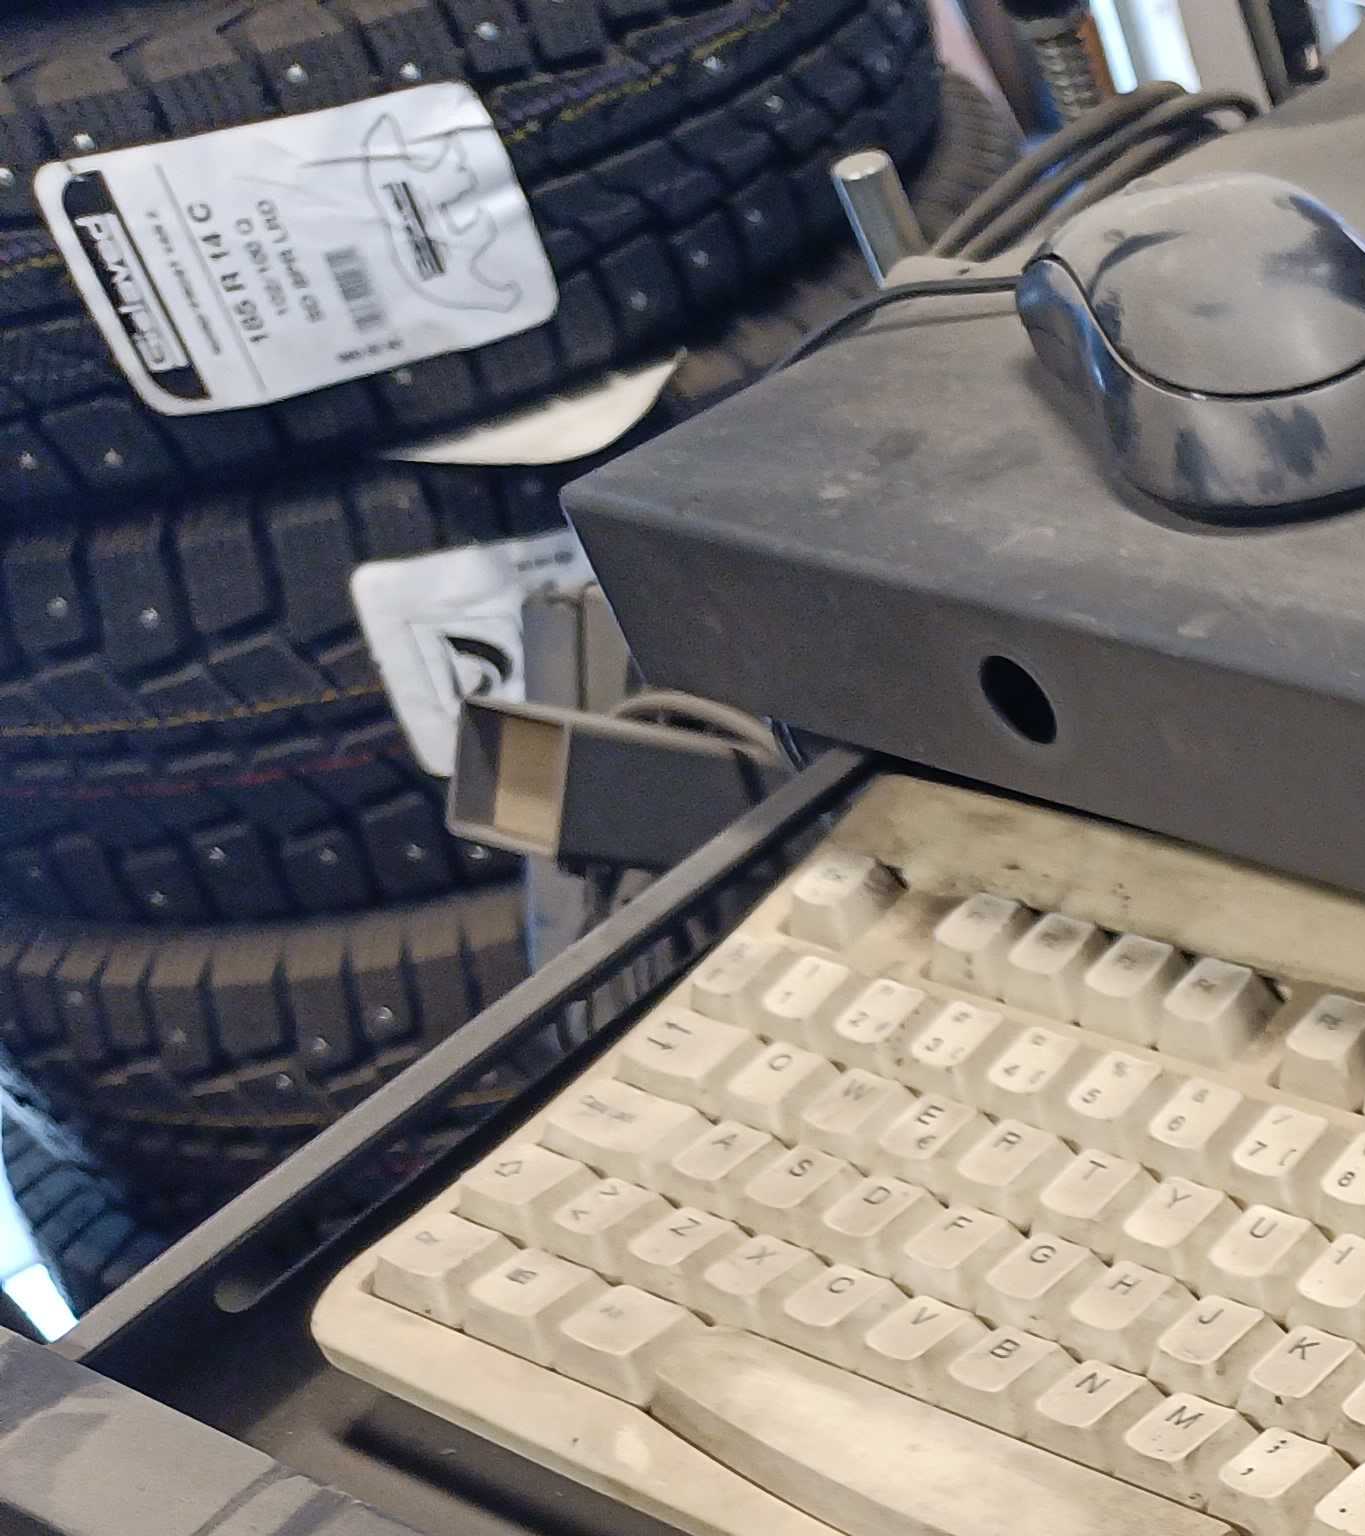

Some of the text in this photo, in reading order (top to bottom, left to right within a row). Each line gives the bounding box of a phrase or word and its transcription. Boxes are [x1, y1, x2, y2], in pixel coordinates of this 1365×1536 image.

[187, 203, 211, 223] C
[220, 271, 245, 292] R
[915, 1104, 945, 1125] E
[788, 1159, 814, 1177] S
[1081, 1159, 1108, 1180] T
[862, 1186, 891, 1206] D
[1167, 1188, 1192, 1208] Y
[669, 1217, 701, 1236] Z
[945, 1216, 973, 1233] F
[1248, 1217, 1278, 1238] U
[745, 1246, 777, 1265] X
[1030, 1245, 1056, 1264] G
[826, 1277, 856, 1294] C
[1109, 1275, 1141, 1295] H
[910, 1307, 939, 1326] V
[1197, 1309, 1224, 1324] J
[989, 1339, 1020, 1359] B
[1287, 1336, 1320, 1360] K
[1075, 1372, 1110, 1394] N
[1165, 1405, 1204, 1430] M
